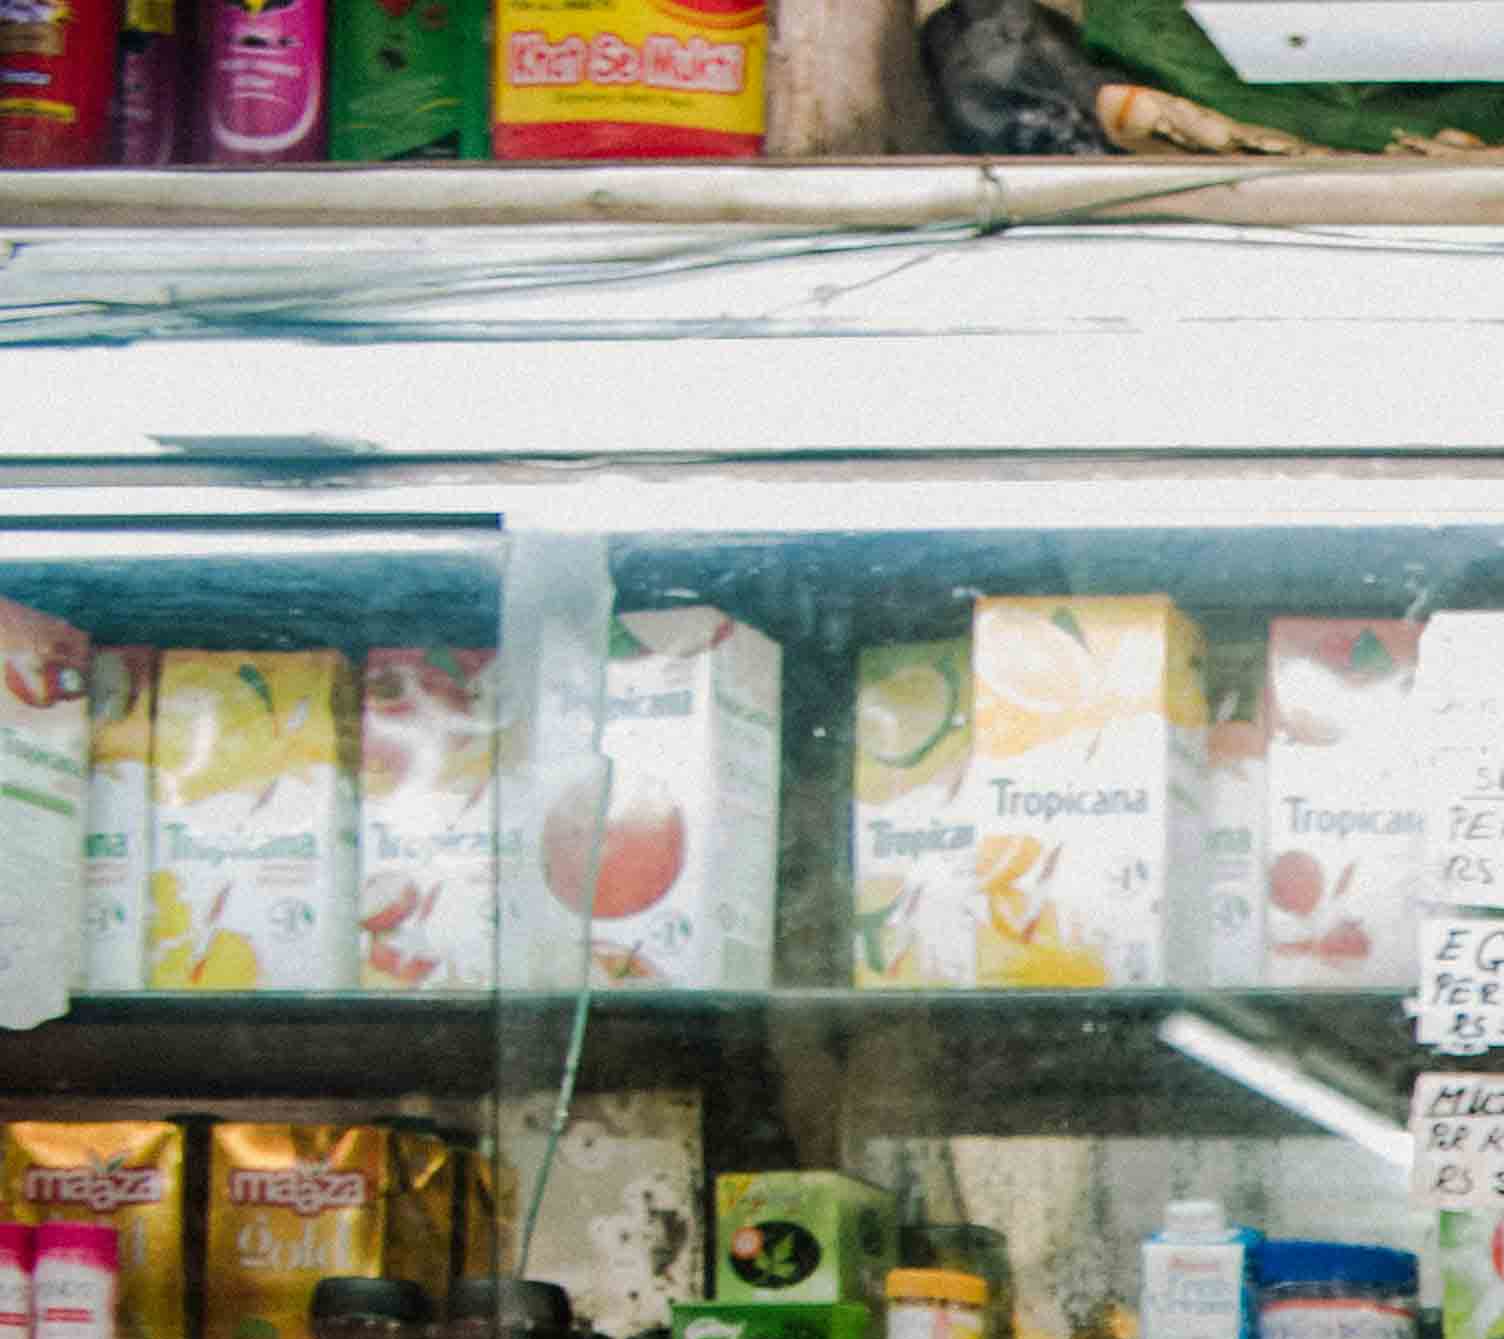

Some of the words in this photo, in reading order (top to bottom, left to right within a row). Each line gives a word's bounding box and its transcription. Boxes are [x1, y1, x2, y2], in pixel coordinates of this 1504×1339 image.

[990, 777, 1148, 822] Tropicana
[28, 1171, 160, 1208] maaza
[234, 1172, 365, 1213] maaza
